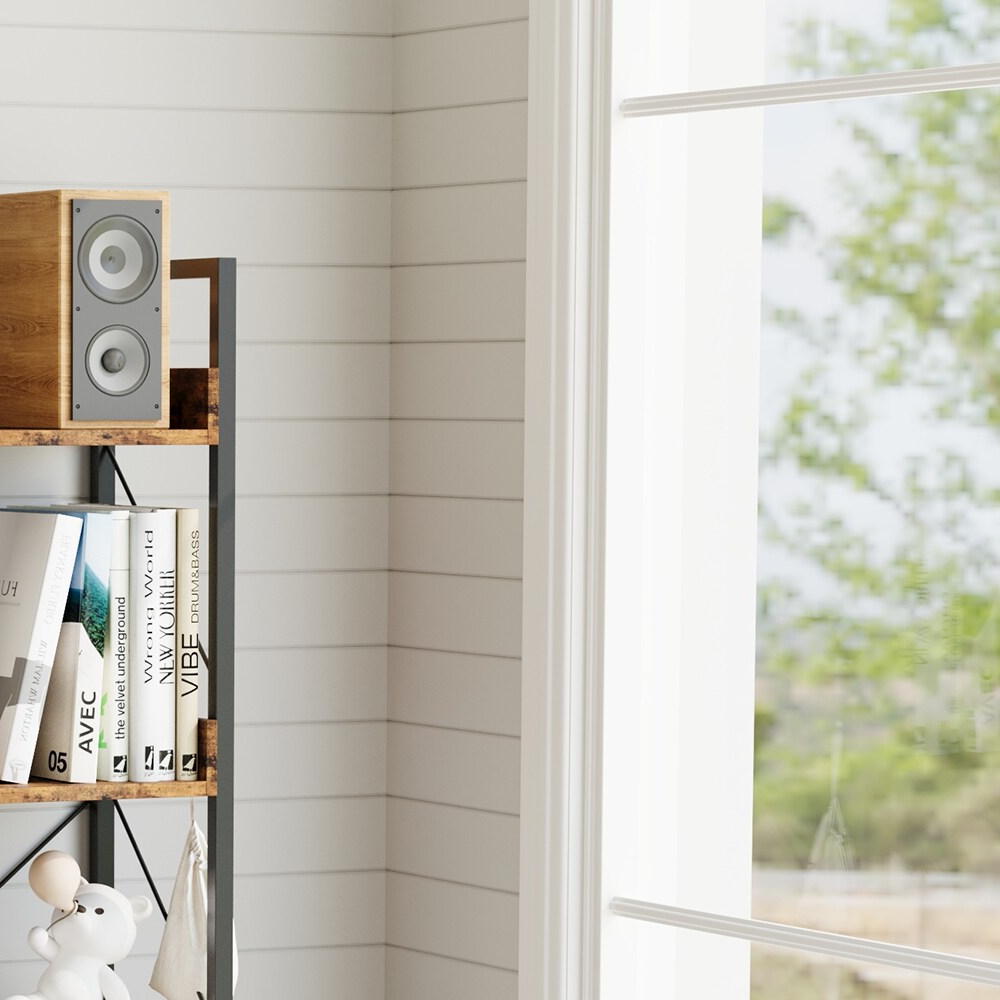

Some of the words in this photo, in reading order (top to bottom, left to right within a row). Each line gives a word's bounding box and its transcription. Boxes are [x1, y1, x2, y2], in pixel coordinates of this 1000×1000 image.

[144, 530, 154, 598] World
[190, 530, 200, 624] DRUM&BASS
[115, 596, 128, 677] underground
[159, 569, 176, 640] YORKER
[144, 607, 155, 684] Wrong
[159, 643, 175, 685] NEW
[181, 633, 199, 698] VIBE
[78, 691, 97, 755] AVEC
[115, 681, 126, 717] velvet
[115, 719, 126, 740] the
[48, 750, 68, 773] 05
